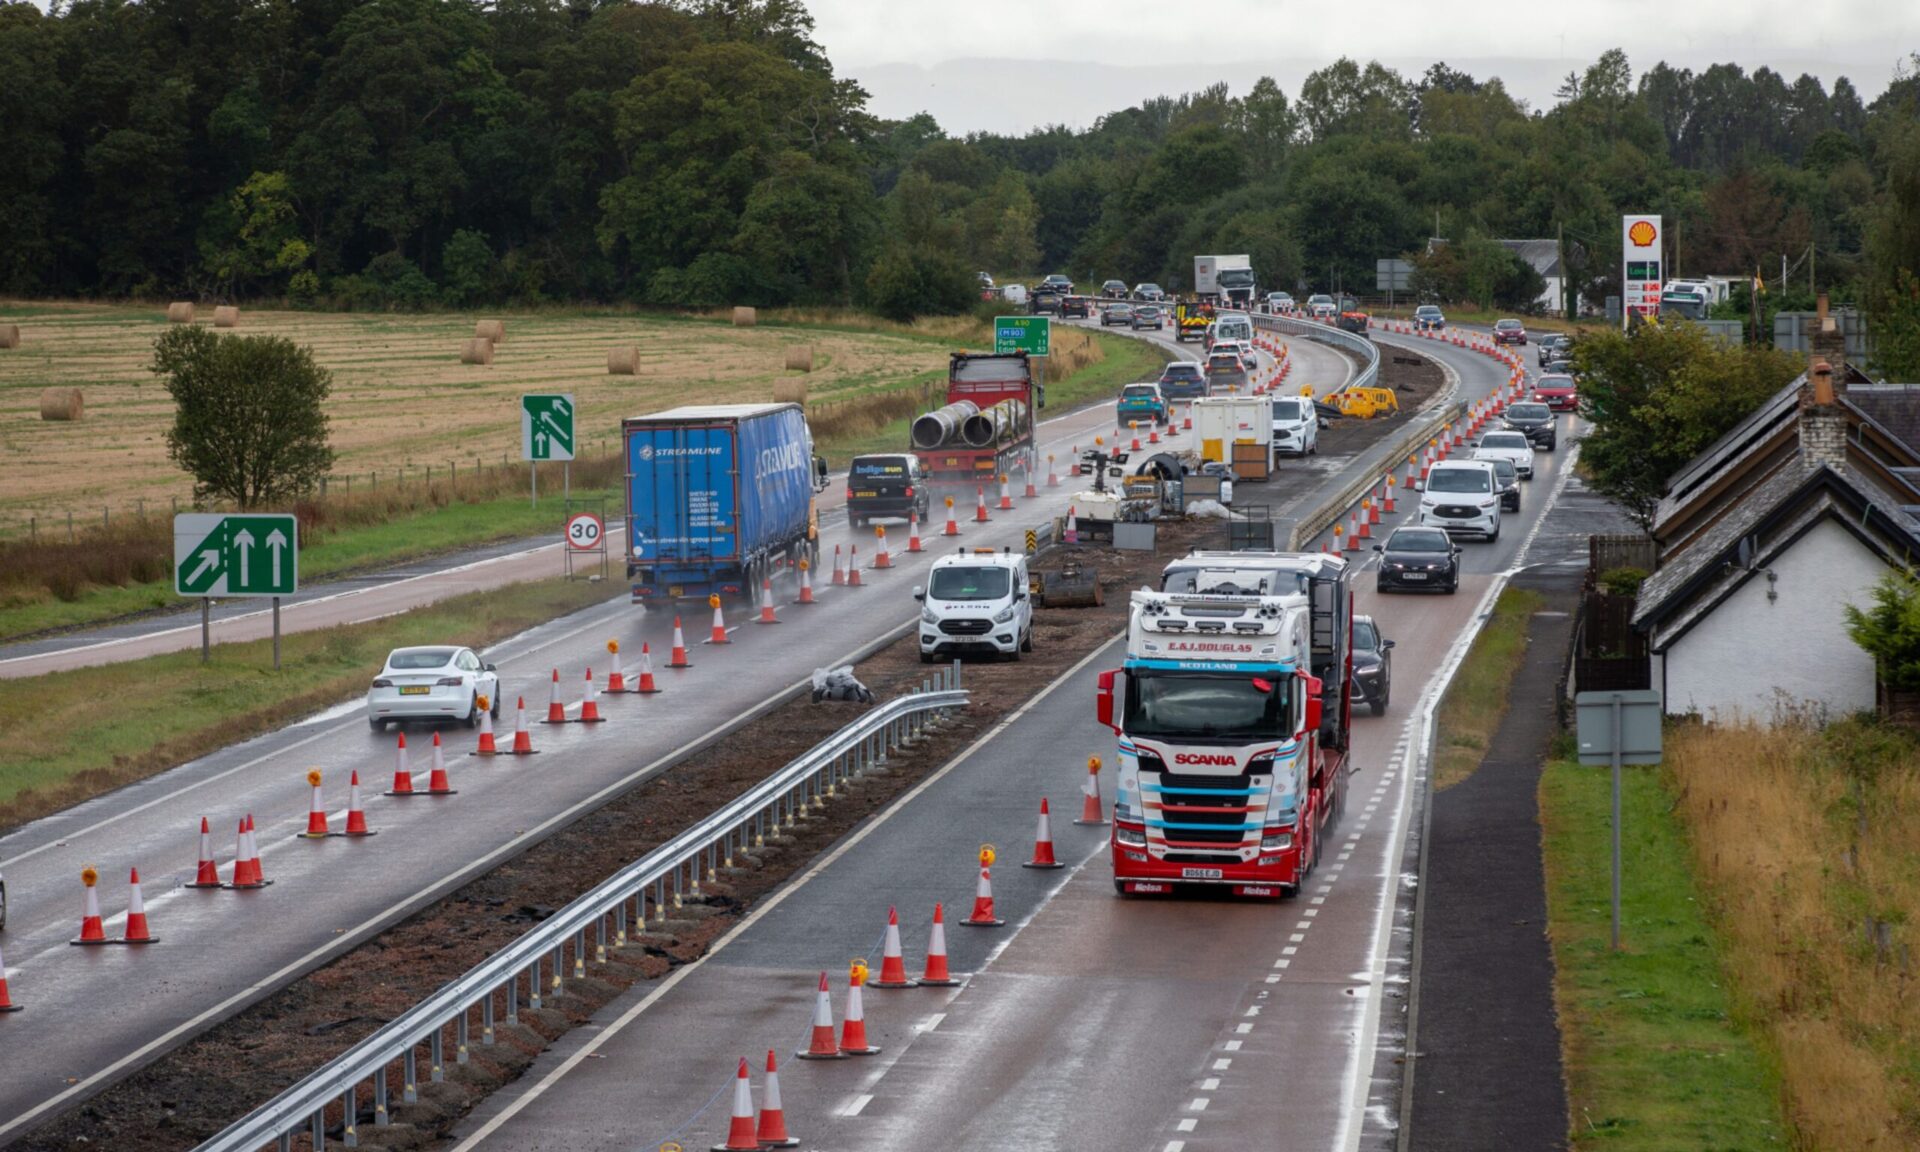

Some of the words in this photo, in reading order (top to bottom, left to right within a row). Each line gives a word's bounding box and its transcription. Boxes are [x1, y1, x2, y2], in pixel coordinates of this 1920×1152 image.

[655, 447, 722, 456] STREAMLINE
[571, 523, 598, 539] 30
[1179, 662, 1237, 670] SCOTLAND
[1174, 753, 1237, 766] SCANIA
